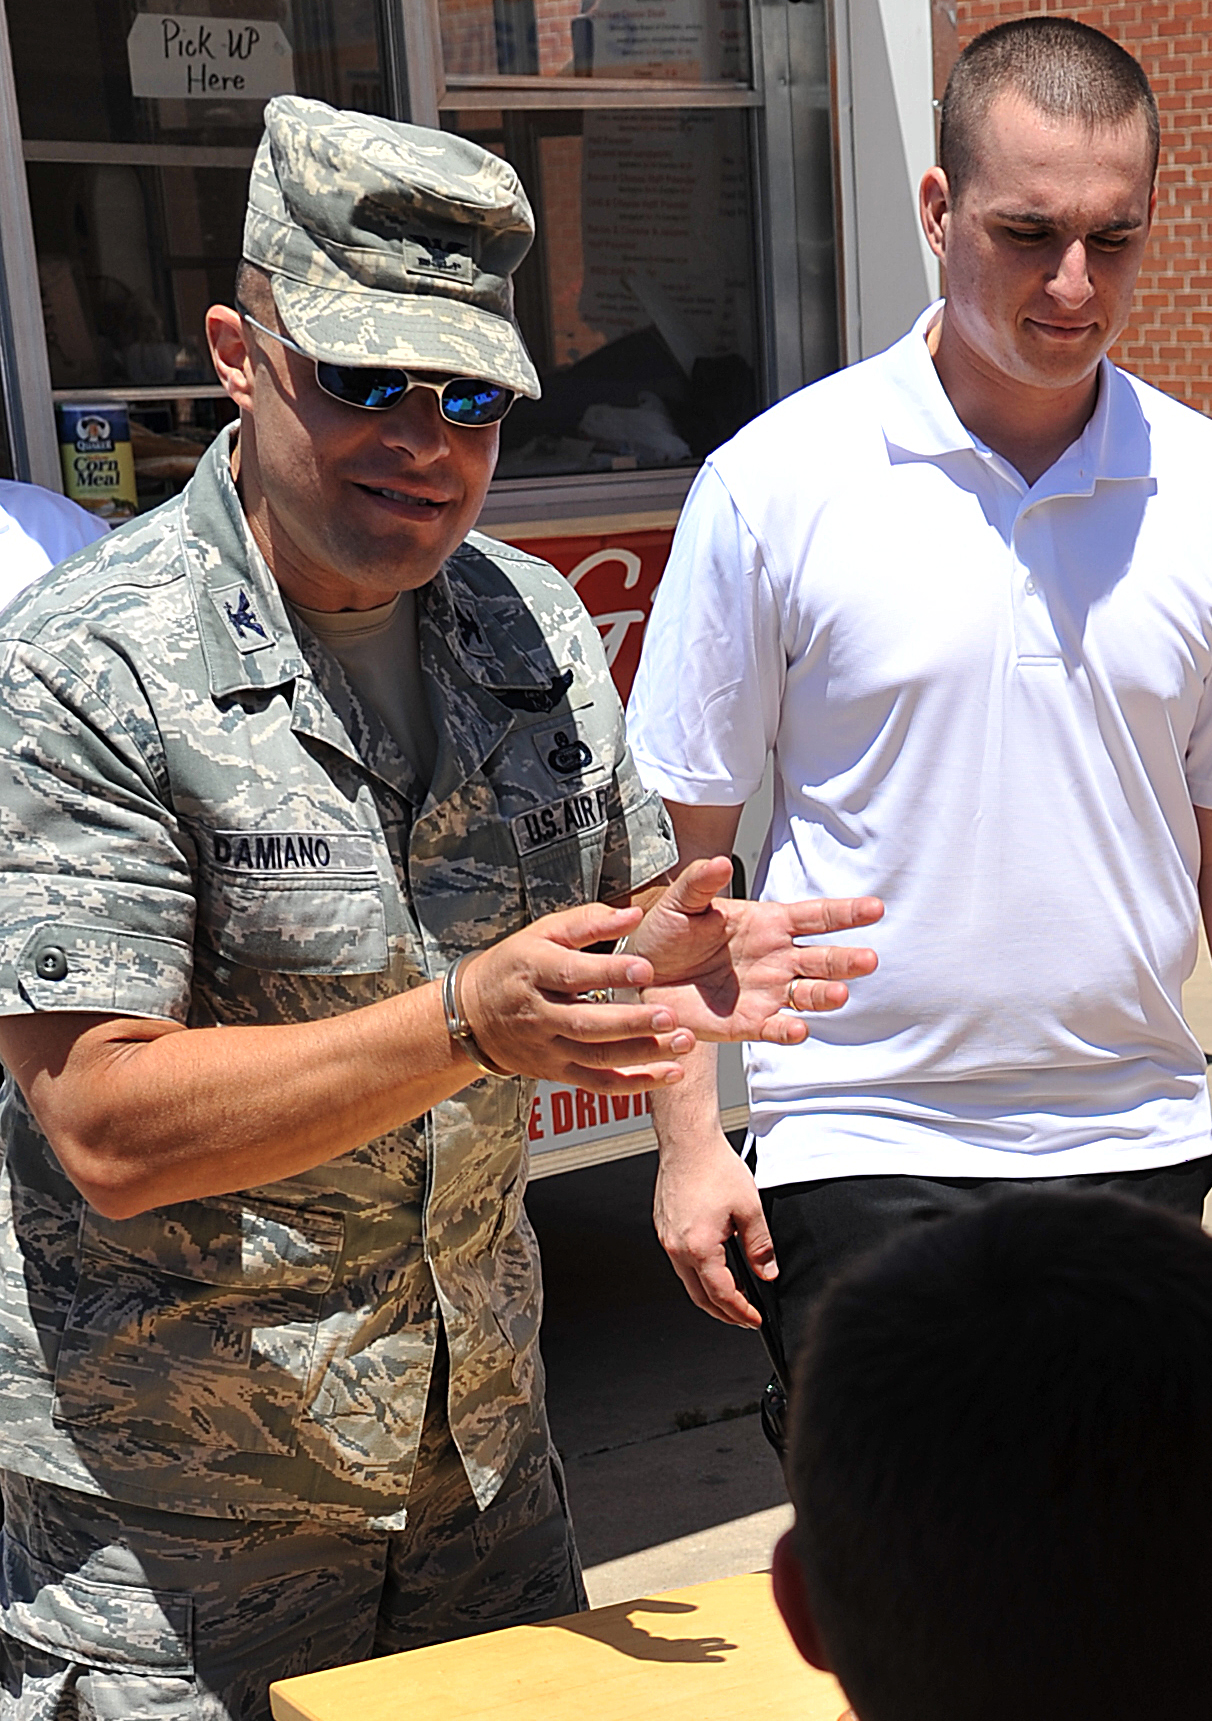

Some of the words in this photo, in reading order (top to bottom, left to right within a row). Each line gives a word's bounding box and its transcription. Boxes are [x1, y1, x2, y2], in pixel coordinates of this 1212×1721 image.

[162, 18, 216, 60] Pick
[187, 63, 246, 94] Here
[74, 456, 119, 472] Corn
[77, 470, 120, 487] Meal
[524, 808, 563, 844] U.S.
[563, 795, 598, 832] AIR
[212, 835, 331, 869] DAMIANO
